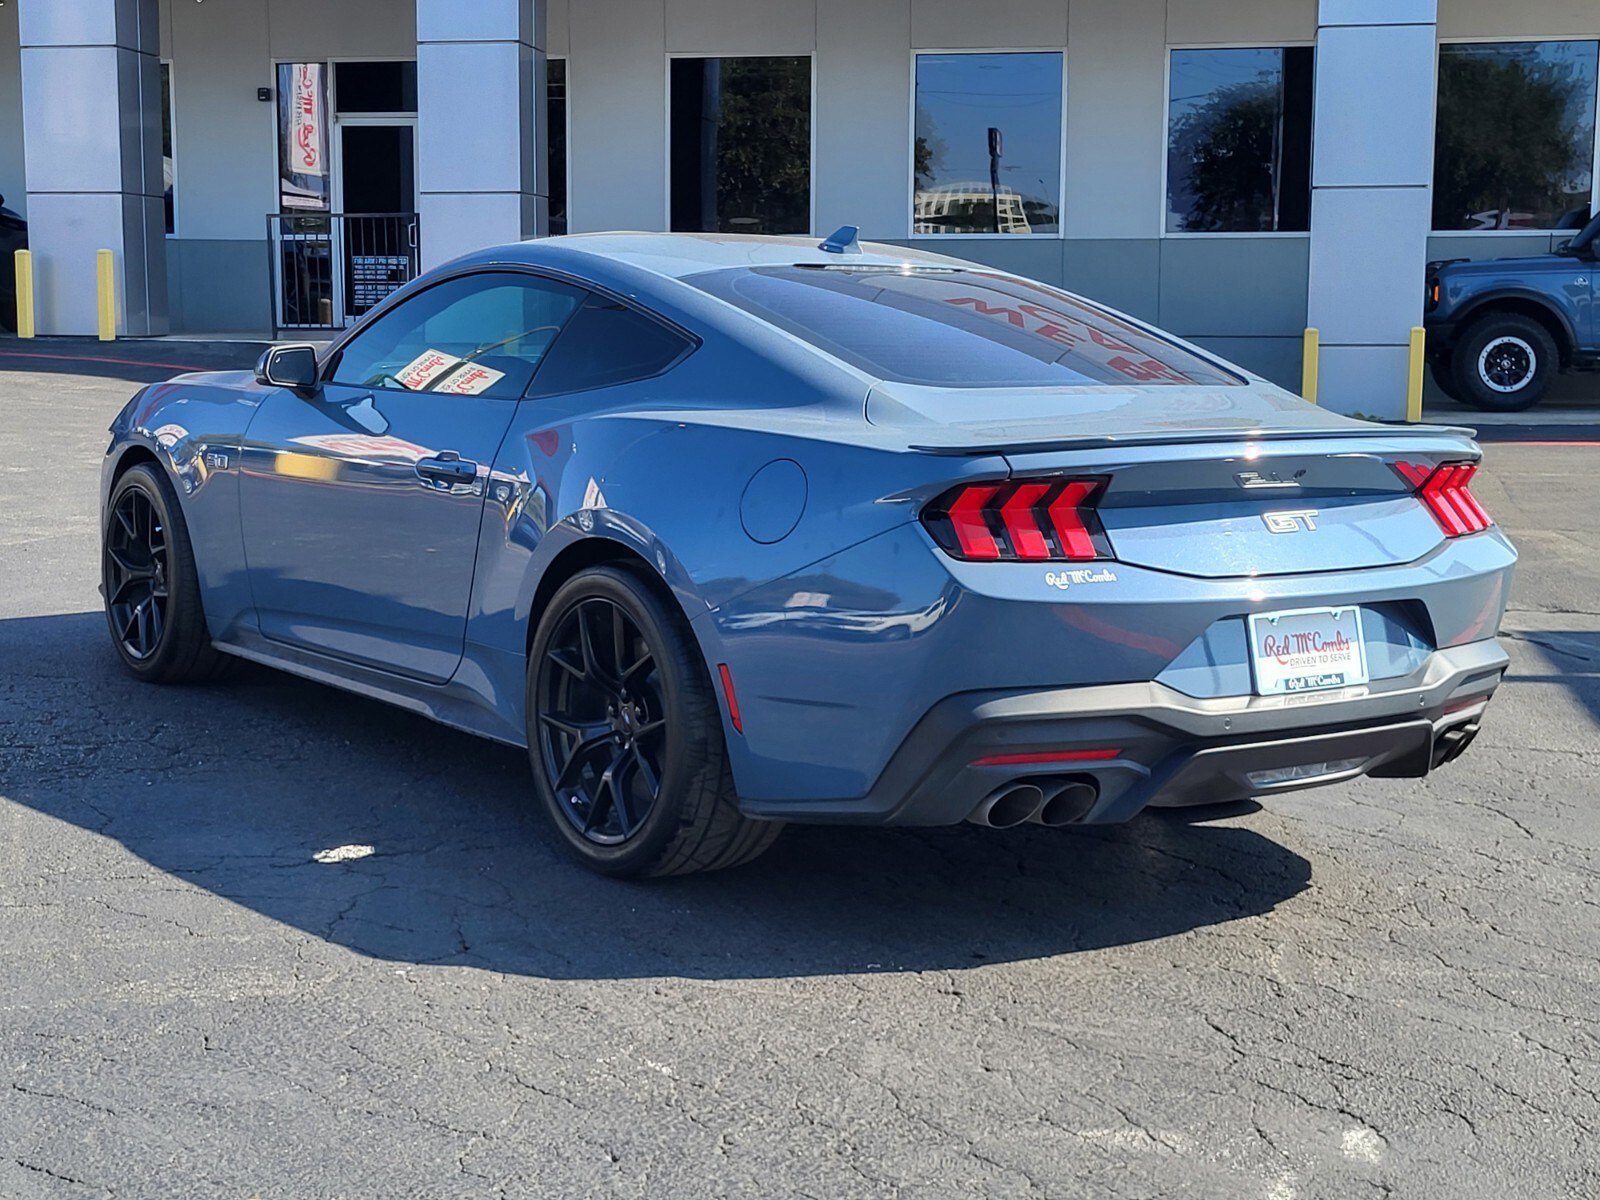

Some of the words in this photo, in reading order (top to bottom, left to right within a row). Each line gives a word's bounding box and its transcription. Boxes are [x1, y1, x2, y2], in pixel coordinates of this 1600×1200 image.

[1261, 509, 1319, 534] GT
[1045, 572, 1069, 589] Red
[1066, 568, 1117, 584] McCombs
[1264, 634, 1291, 665] Red
[1291, 630, 1350, 654] McCombs
[1290, 655, 1317, 665] DRIVEN
[1318, 655, 1329, 663] TO
[1330, 653, 1351, 662] SERVE
[1288, 678, 1306, 689] Red
[1306, 675, 1341, 686] McCombs
